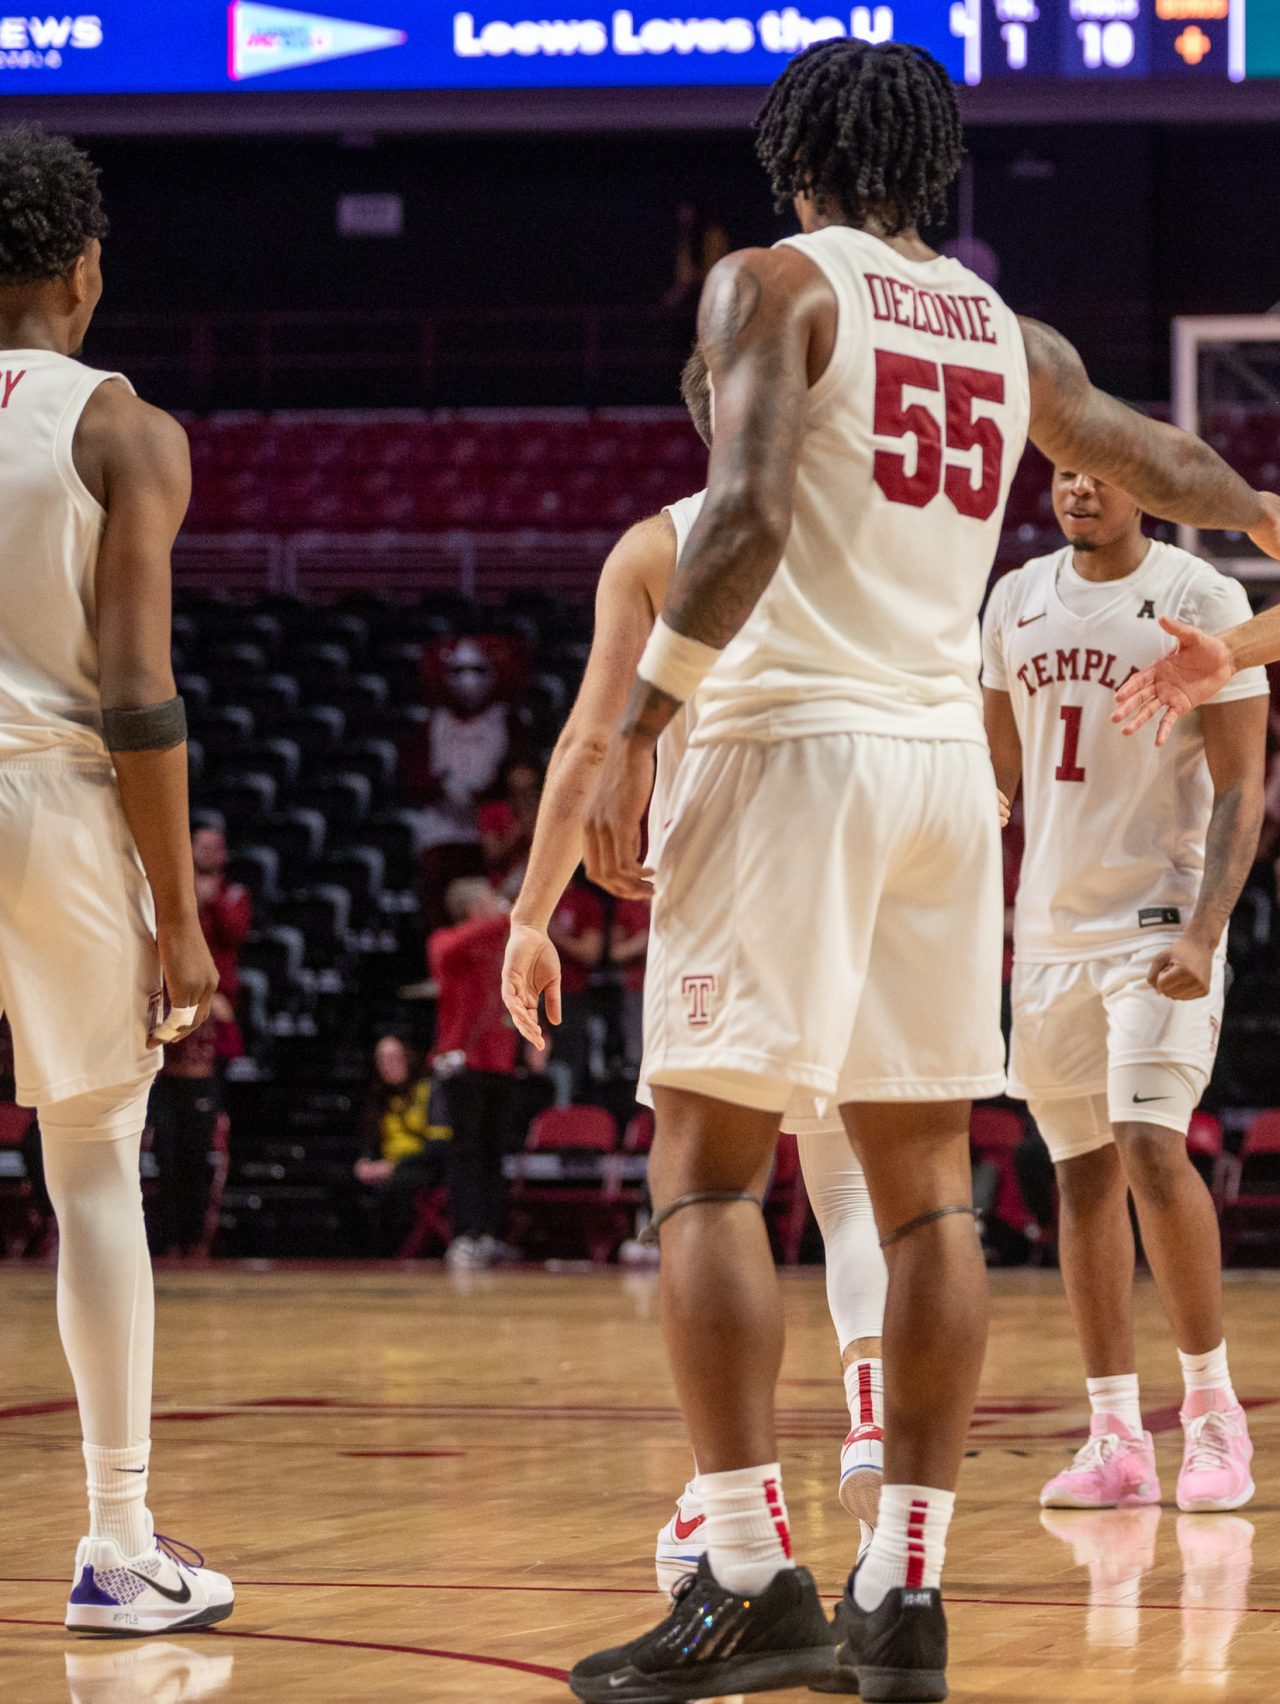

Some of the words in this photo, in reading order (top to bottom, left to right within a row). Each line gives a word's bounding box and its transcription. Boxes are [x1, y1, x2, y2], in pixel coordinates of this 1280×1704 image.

[453, 11, 607, 57] Loews
[612, 9, 754, 55] Loves
[1000, 22, 1028, 70] 1
[1077, 20, 1135, 68] 10
[864, 273, 997, 344] DEZONIE
[873, 348, 1005, 521] 55
[1055, 705, 1085, 782] 1
[682, 975, 716, 1026] T
